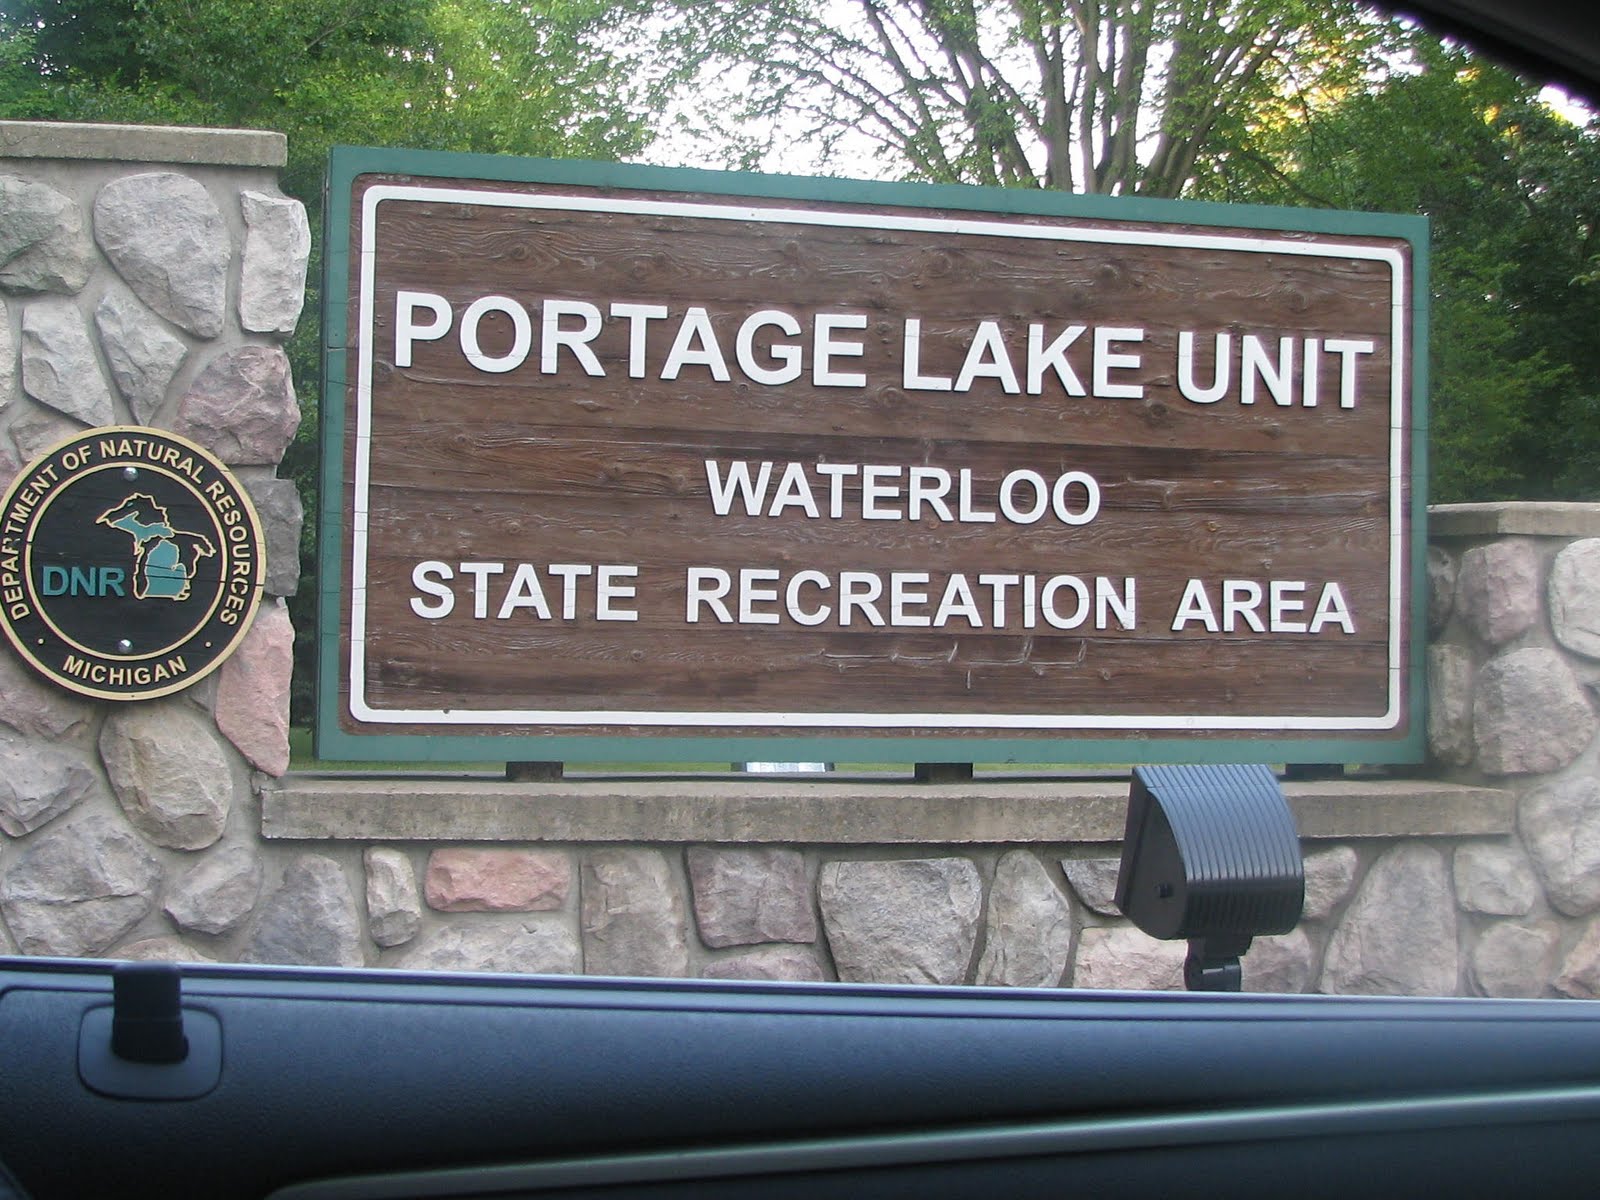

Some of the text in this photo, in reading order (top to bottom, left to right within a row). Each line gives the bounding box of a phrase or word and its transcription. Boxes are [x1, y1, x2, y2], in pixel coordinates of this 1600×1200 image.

[395, 290, 1375, 408] PORTAGE LAKE UNIT
[704, 459, 1101, 525] WATERLOO
[1, 439, 251, 626] DEPARTMENT OF NATURAL RESOURCES
[42, 566, 125, 597] DNR
[409, 560, 1356, 634] STATE RECREATION AREA
[62, 655, 187, 686] MICHIGAN
